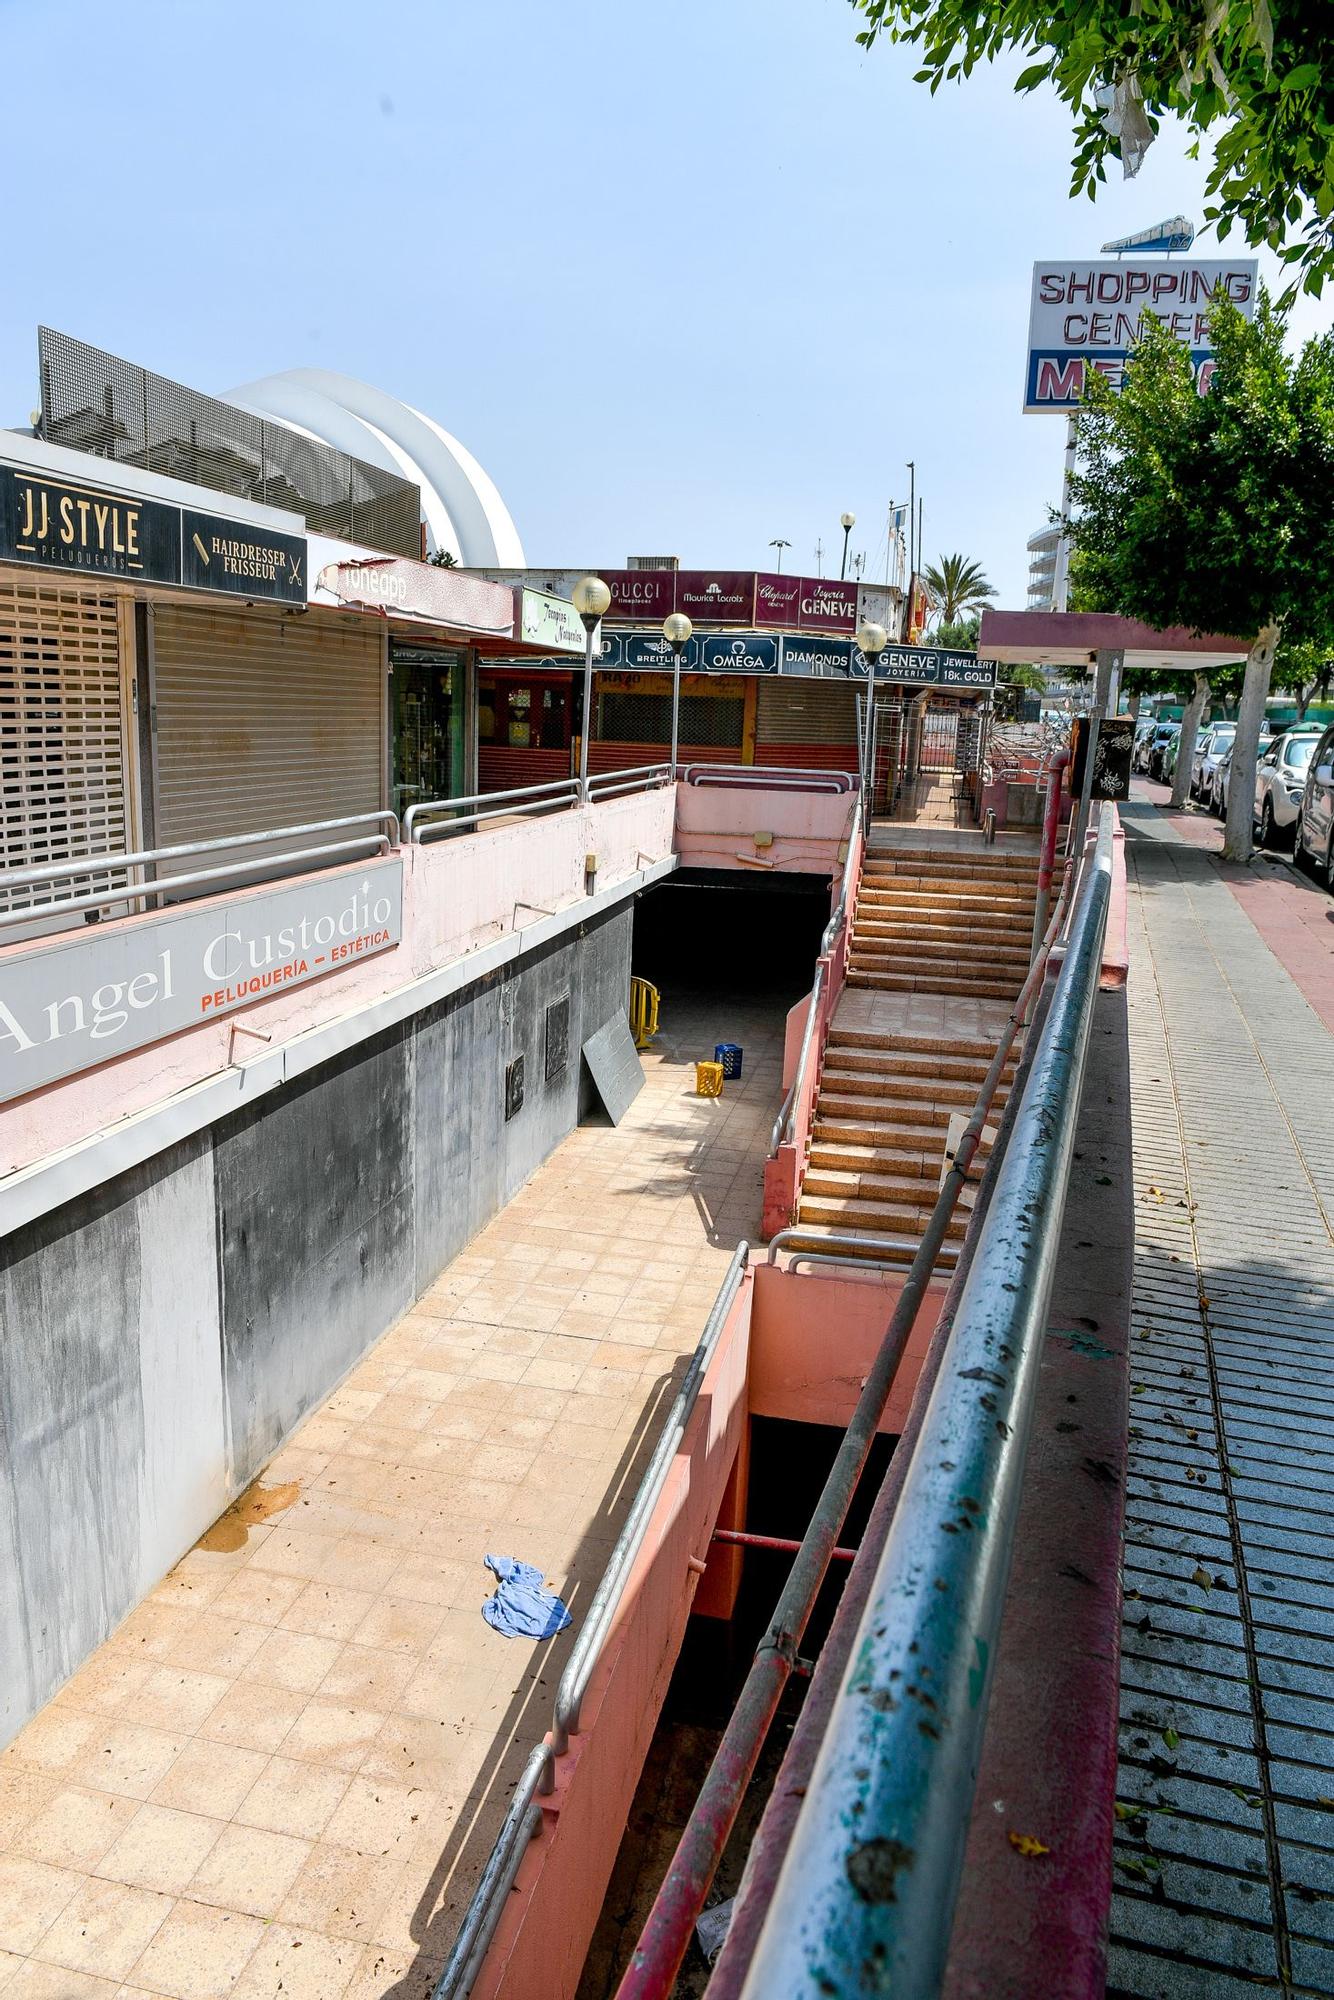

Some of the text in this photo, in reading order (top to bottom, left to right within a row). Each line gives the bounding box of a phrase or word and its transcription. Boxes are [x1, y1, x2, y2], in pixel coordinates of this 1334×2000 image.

[1039, 270, 1252, 304] SHOPPING
[22, 488, 139, 556] JJ STYLE
[42, 545, 125, 570] PELUQUEROS
[212, 536, 287, 567] HAIRDRESSER
[224, 556, 277, 581] FRISSEUR
[610, 582, 660, 598] GUCCI
[683, 594, 743, 603] Maurice Lacroix
[758, 583, 799, 602] Chopard
[801, 598, 855, 618] GENEVE
[636, 655, 688, 663] BREITLIG
[713, 655, 765, 668] OMEGA
[785, 651, 848, 667] DIAMONDS
[878, 652, 936, 669] GENEVE
[943, 656, 994, 669] JEWELLERY
[964, 671, 992, 682] GOLD
[202, 876, 392, 981] Custodio
[201, 958, 308, 1012] PELUQUERÍA
[331, 929, 390, 962] ESTÉTICA
